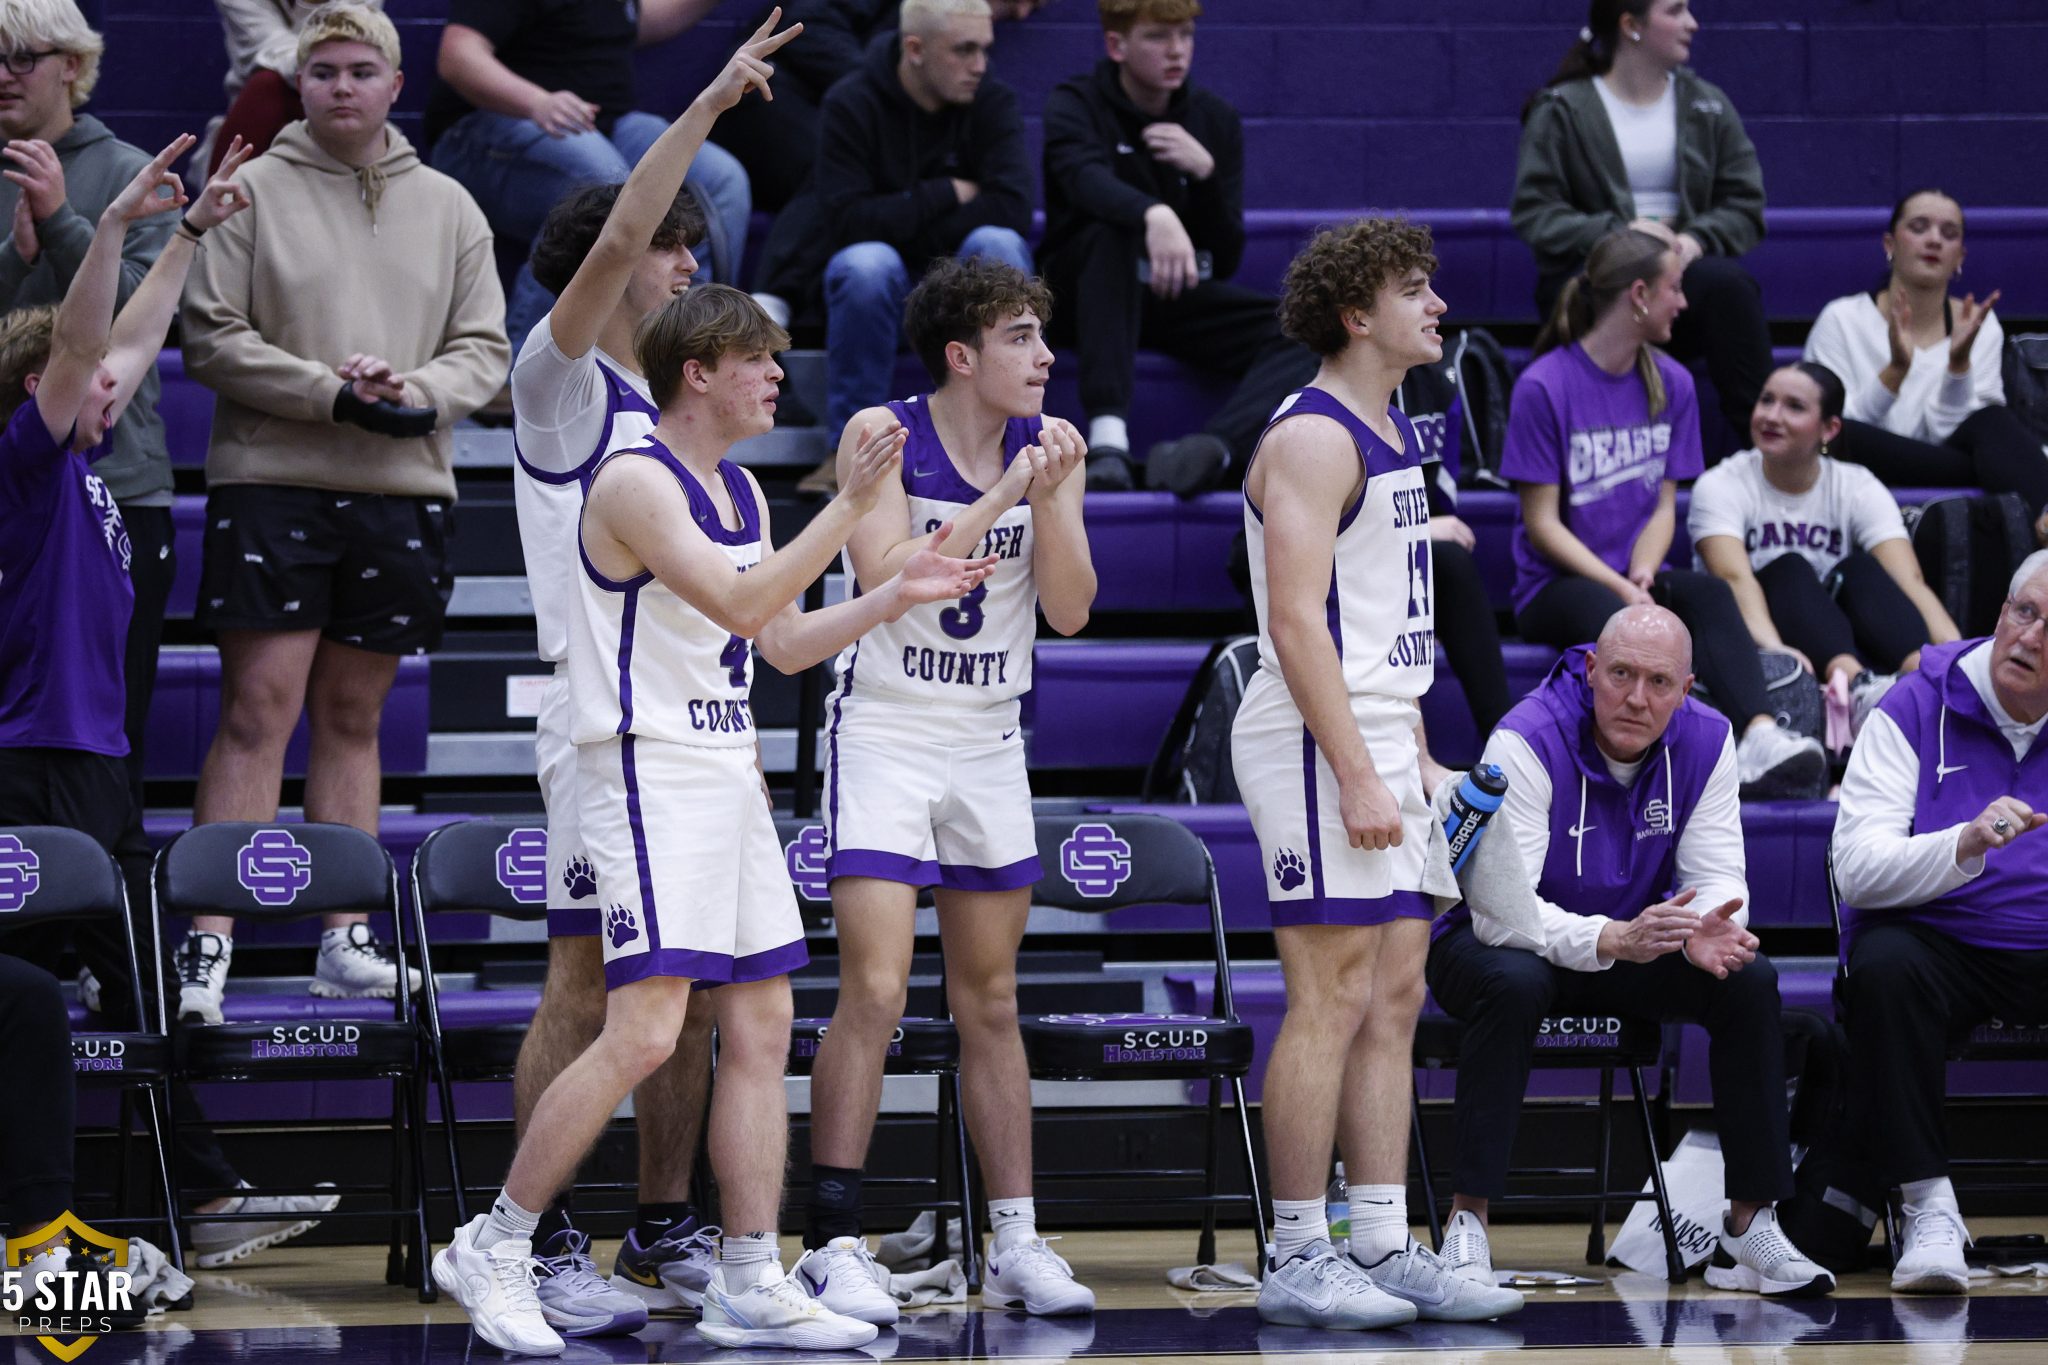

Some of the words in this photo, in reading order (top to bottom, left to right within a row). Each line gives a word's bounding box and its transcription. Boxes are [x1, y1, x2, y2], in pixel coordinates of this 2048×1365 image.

[1568, 423, 1672, 486] BEARS
[938, 580, 990, 640] 3
[720, 632, 750, 688] 4
[902, 645, 1010, 687] COUNTY
[251, 1039, 359, 1058] HOMESTORE
[1103, 1044, 1206, 1063] HOMESTORE
